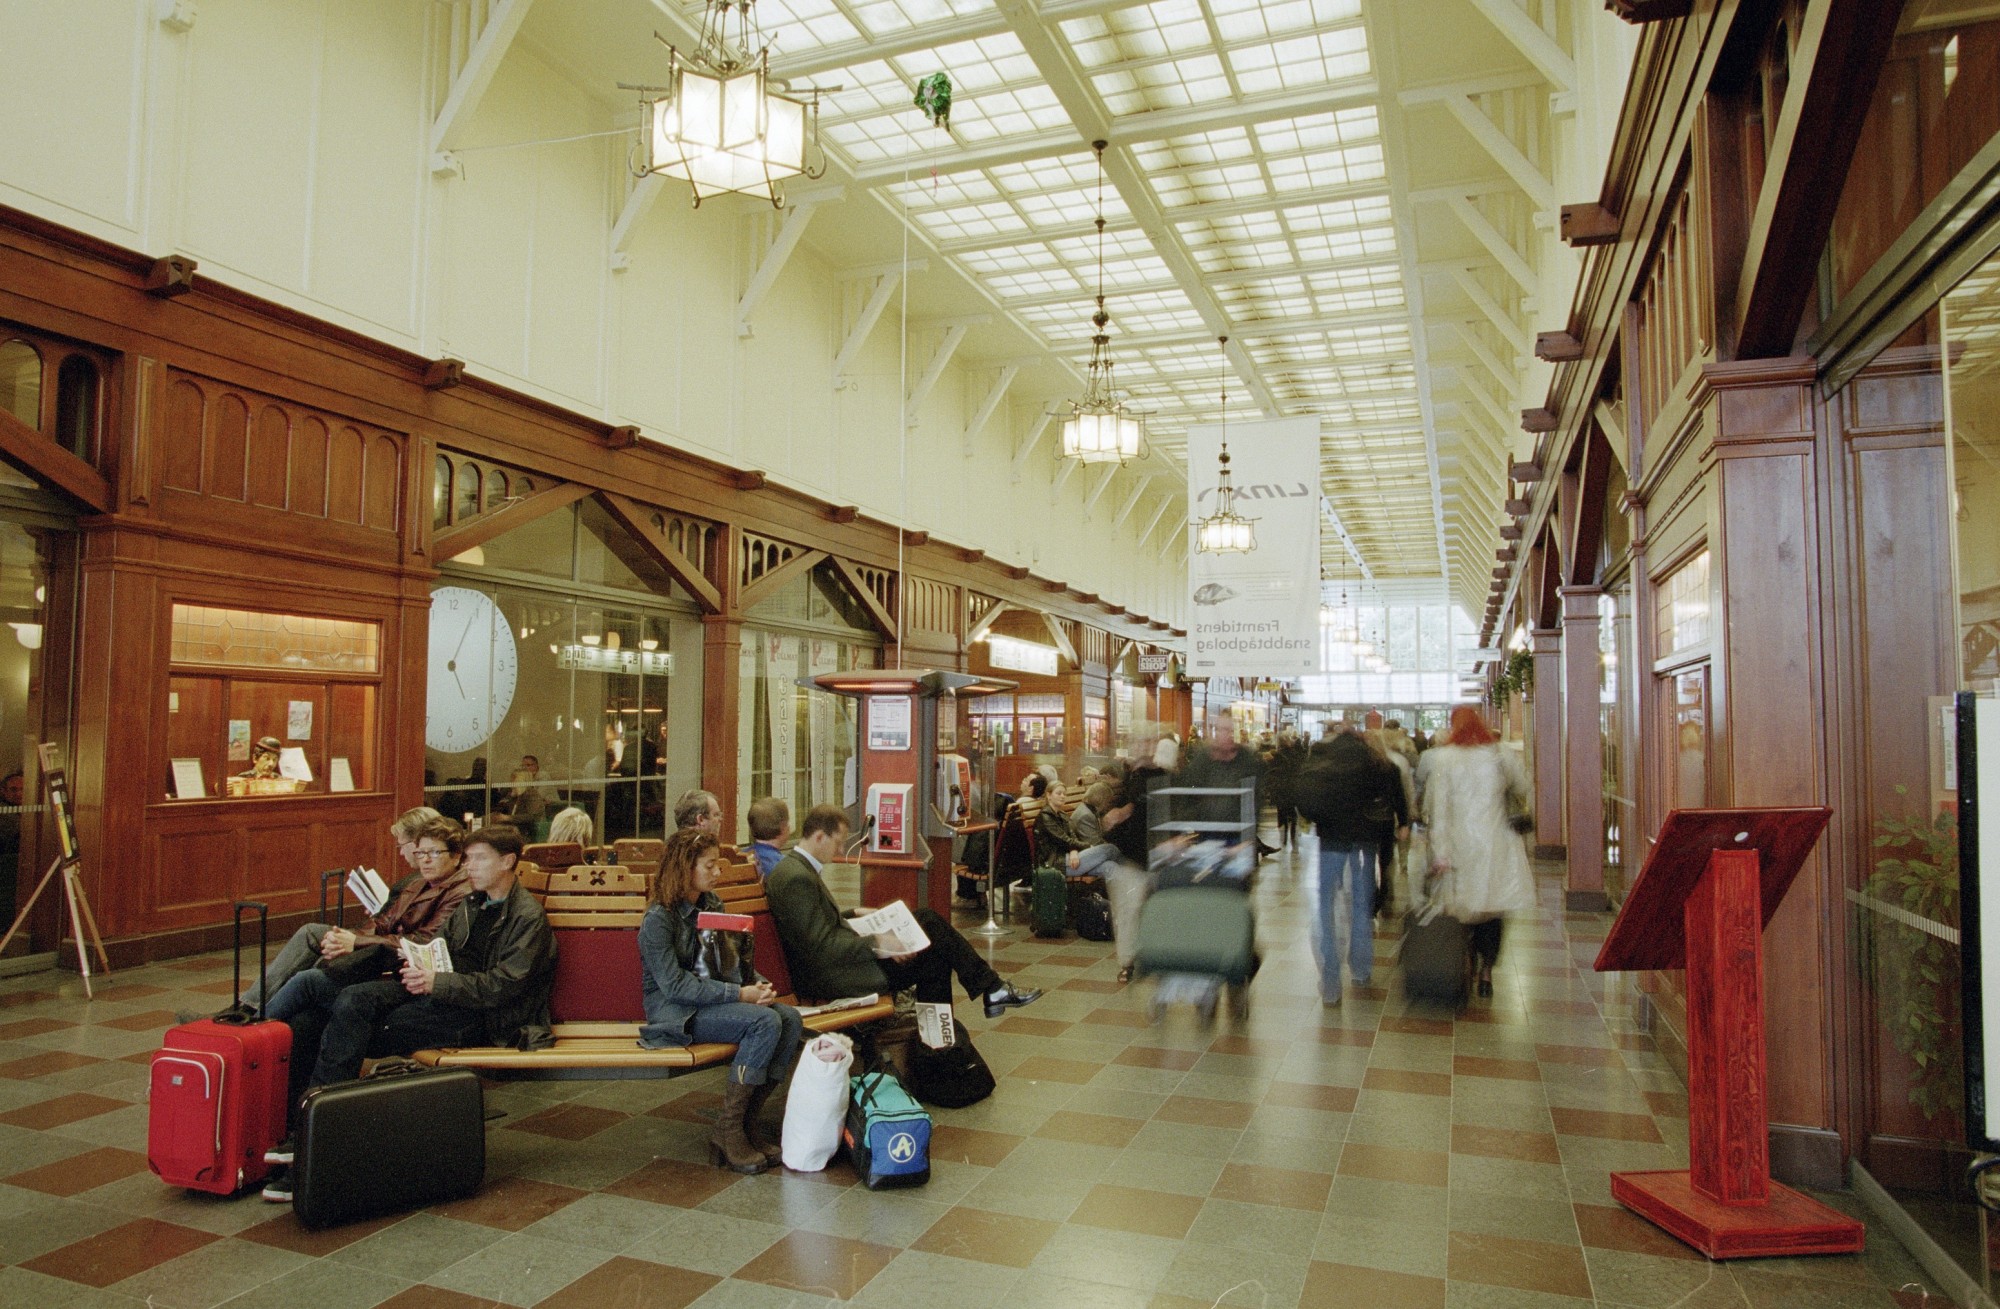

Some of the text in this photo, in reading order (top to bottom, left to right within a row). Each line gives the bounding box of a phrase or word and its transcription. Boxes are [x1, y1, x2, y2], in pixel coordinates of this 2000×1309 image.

[450, 600, 459, 610] 12
[498, 660, 505, 671] 3
[1140, 663, 1166, 671] SHOP
[472, 718, 479, 730] 5
[446, 726, 453, 738] 6
